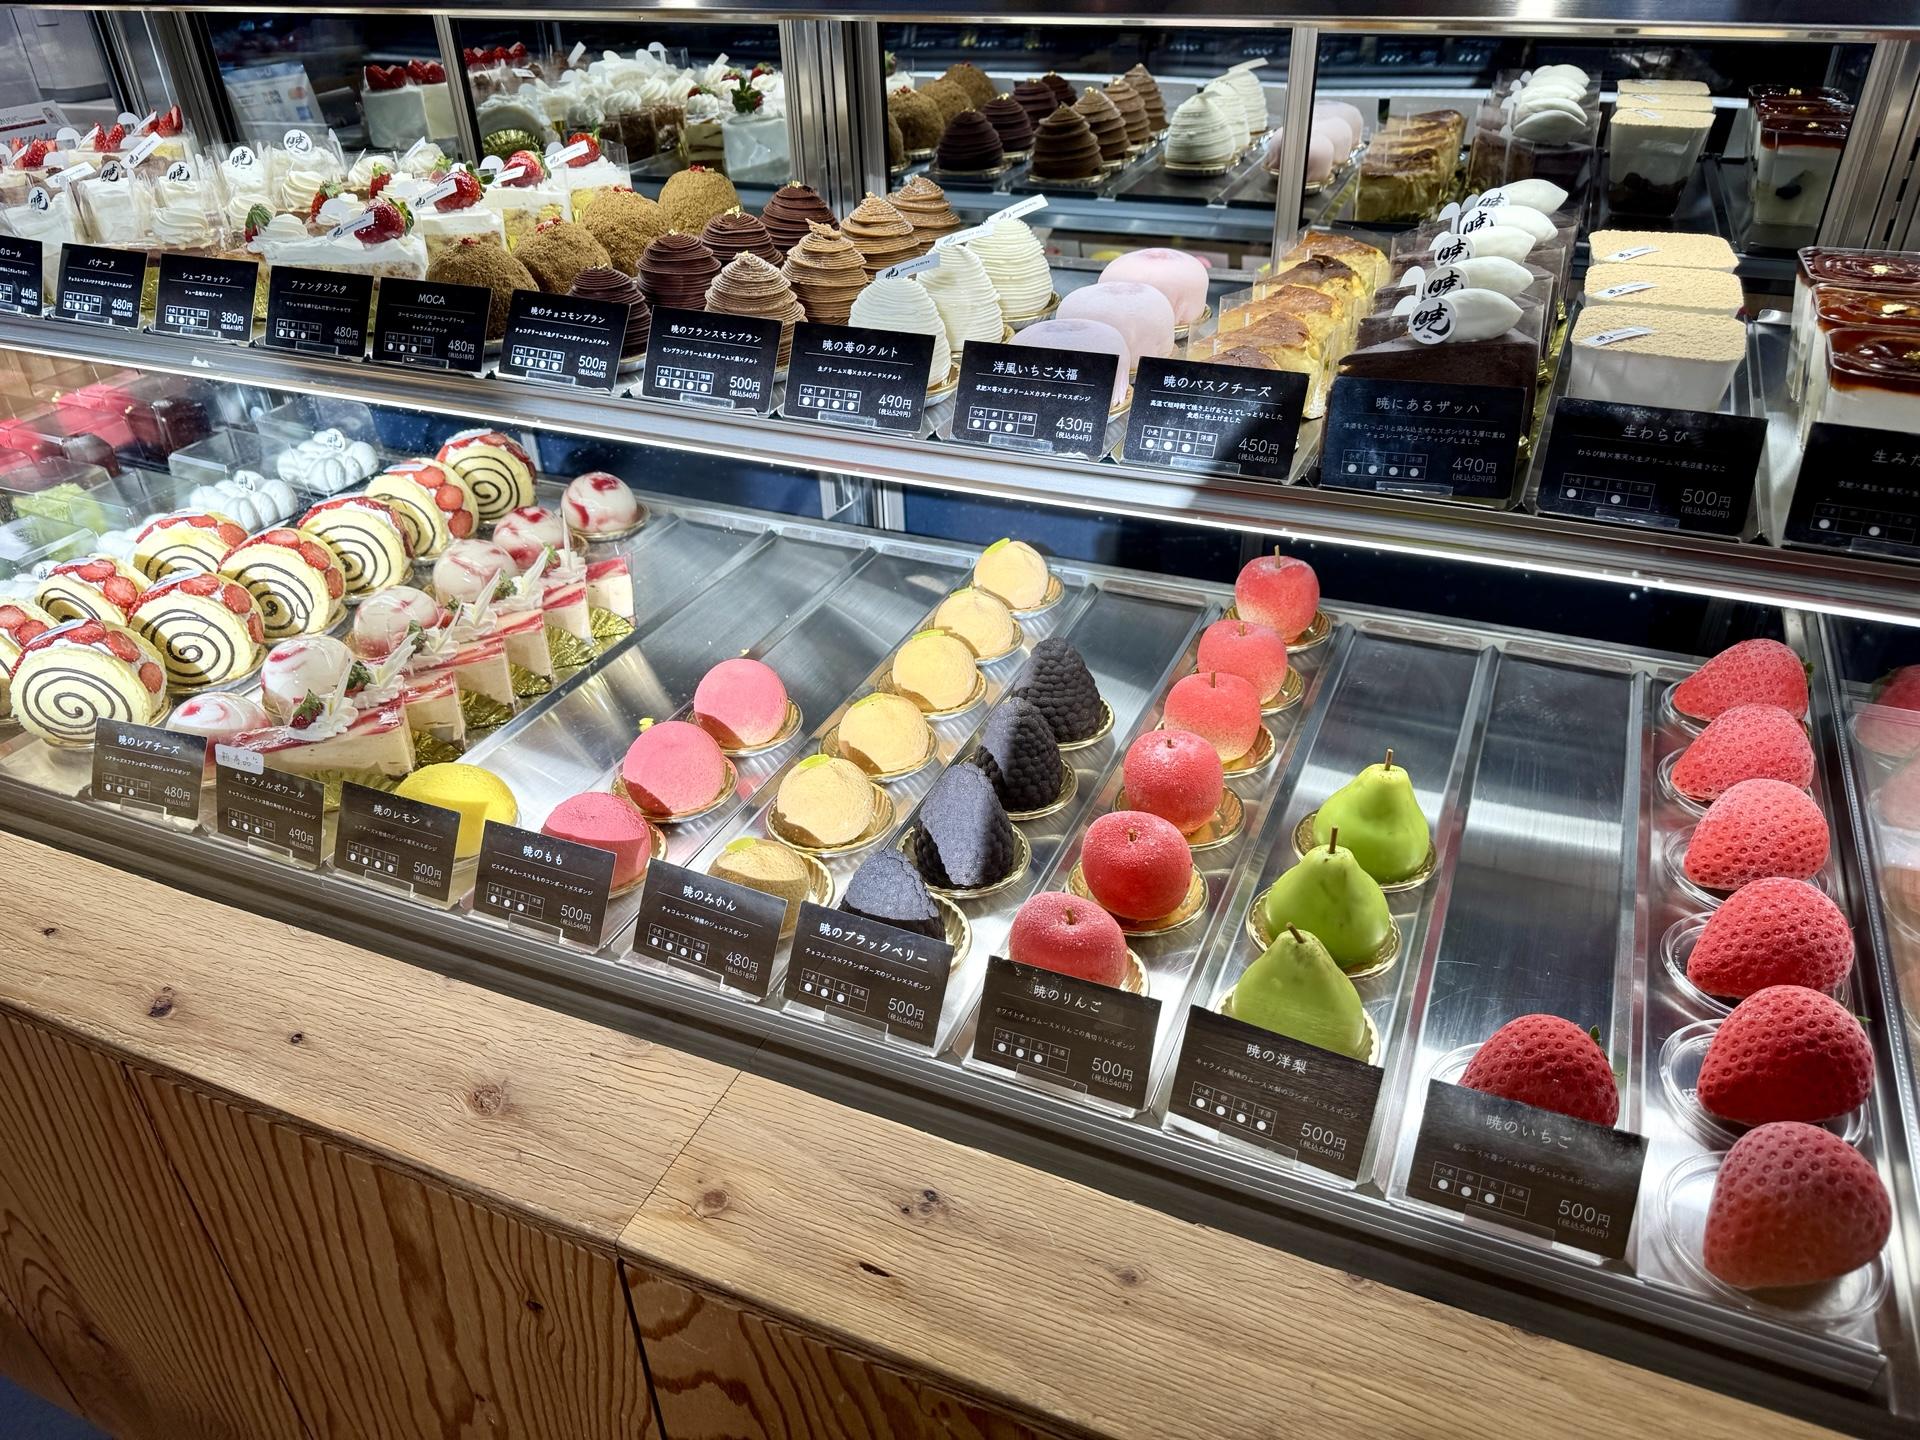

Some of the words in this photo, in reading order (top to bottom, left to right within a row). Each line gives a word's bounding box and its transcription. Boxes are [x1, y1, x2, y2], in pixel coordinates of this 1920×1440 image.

[291, 280, 347, 294] ファンタジスタ
[111, 298, 133, 311] 480円
[418, 294, 446, 305] MOCA
[221, 312, 244, 325] 380円
[530, 306, 605, 324] 暁のチョコモンブラン
[1413, 303, 1450, 336] 暁
[334, 326, 359, 339] 480円
[671, 324, 762, 343] 暁のフランスモンブラン
[448, 340, 475, 353] 480円
[822, 339, 898, 358] 暁の苺のタルト
[578, 355, 607, 371] 500円
[993, 361, 1079, 381] 洋風いちご大福
[729, 376, 761, 392] 500円
[1163, 375, 1272, 398] 暁のバスクチーズ
[878, 394, 912, 410] 490円
[1376, 397, 1480, 414] 暁にあるザッハ
[1056, 417, 1093, 433] 430円
[1621, 425, 1689, 443] 生わらび
[1056, 431, 1092, 442] (税込464円)
[1238, 437, 1280, 455] 450円
[1238, 452, 1278, 465] (税込486円)
[1452, 457, 1497, 474] 490円
[1681, 488, 1732, 509] 500円
[118, 735, 180, 755] 暁のレアチーズ
[164, 786, 191, 801] 480円
[235, 773, 305, 799] キャラメルポワール
[373, 804, 420, 825] 暁のレモン
[289, 827, 314, 845] 490円
[523, 845, 563, 866] 暁のもも
[413, 861, 442, 880] 500円
[682, 884, 737, 912] 暁のみかん
[560, 904, 592, 924] 500円
[819, 922, 928, 963] 暁のブラックベリー
[725, 951, 759, 974] 480円
[1033, 984, 1103, 1013] 暁のりんご
[888, 997, 925, 1021] 500円
[1246, 1042, 1309, 1075] 暁の洋梨
[1091, 1057, 1134, 1082] 500円
[1300, 1121, 1347, 1151] 500円
[1486, 1114, 1572, 1150] 暁のいちご
[1558, 1199, 1611, 1229] 500円
